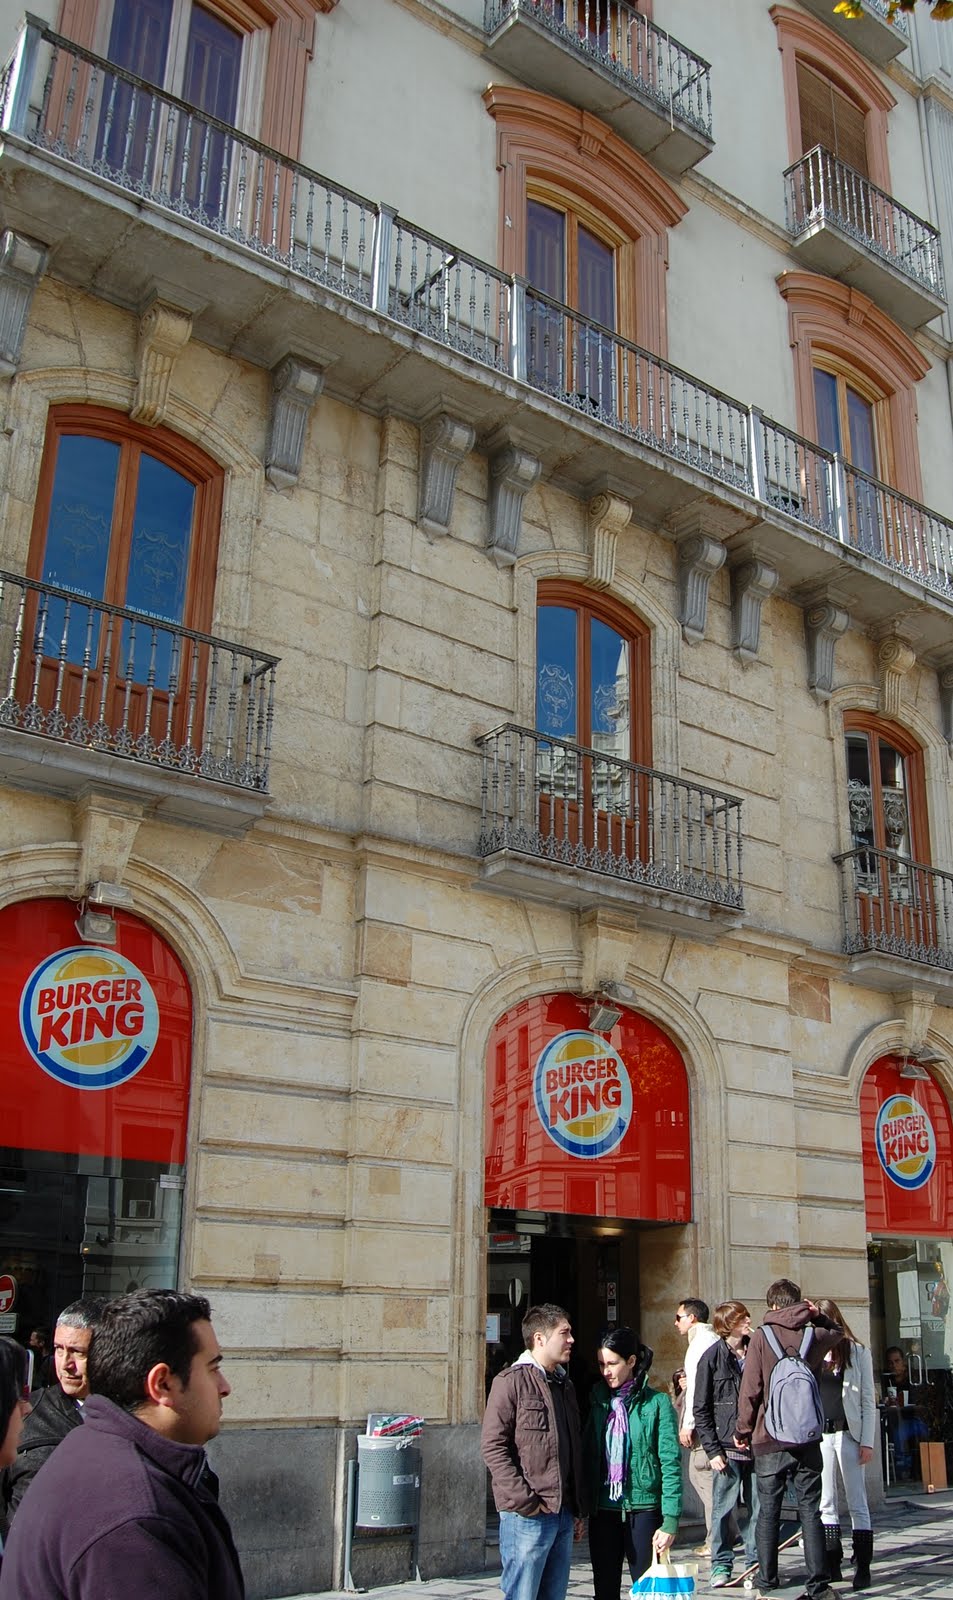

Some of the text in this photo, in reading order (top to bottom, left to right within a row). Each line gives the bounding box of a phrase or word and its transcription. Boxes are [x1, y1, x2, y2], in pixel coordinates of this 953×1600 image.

[37, 979, 142, 1015] BURGER
[39, 1002, 144, 1051] KING
[546, 1058, 618, 1094] BURGER
[550, 1079, 622, 1127] KING
[882, 1115, 926, 1142] BURGER
[885, 1131, 929, 1166] KING
